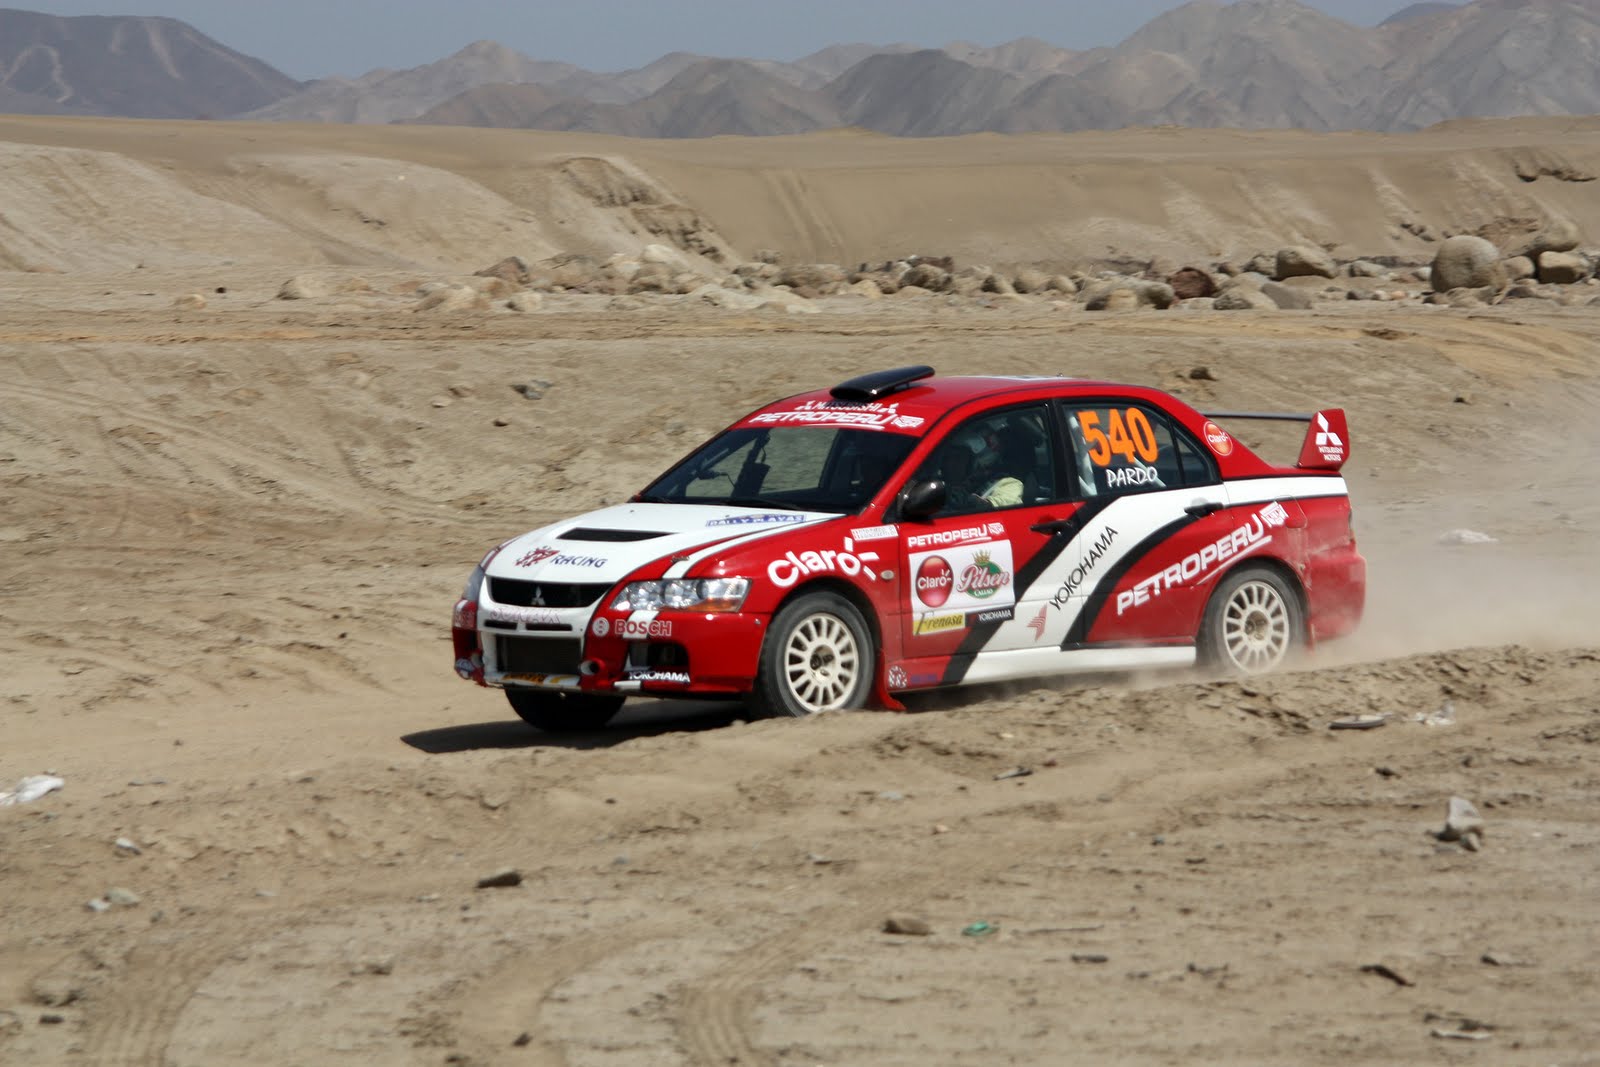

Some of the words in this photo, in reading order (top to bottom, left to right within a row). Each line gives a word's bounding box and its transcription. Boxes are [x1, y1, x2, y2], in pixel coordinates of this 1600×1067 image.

[748, 411, 898, 425] PETROPERU
[1077, 407, 1158, 468] 540
[1106, 466, 1158, 488] PARDO
[907, 524, 988, 548] PETROPERU
[550, 554, 608, 568] RACING
[1049, 525, 1119, 611] YOKOHAMA
[1117, 513, 1264, 616] PETROPERU
[956, 564, 1010, 593] Pilsen
[978, 609, 1012, 622] YOKOHAMA
[614, 619, 672, 636] BOSCH
[629, 670, 691, 683] YOKOHAMA
